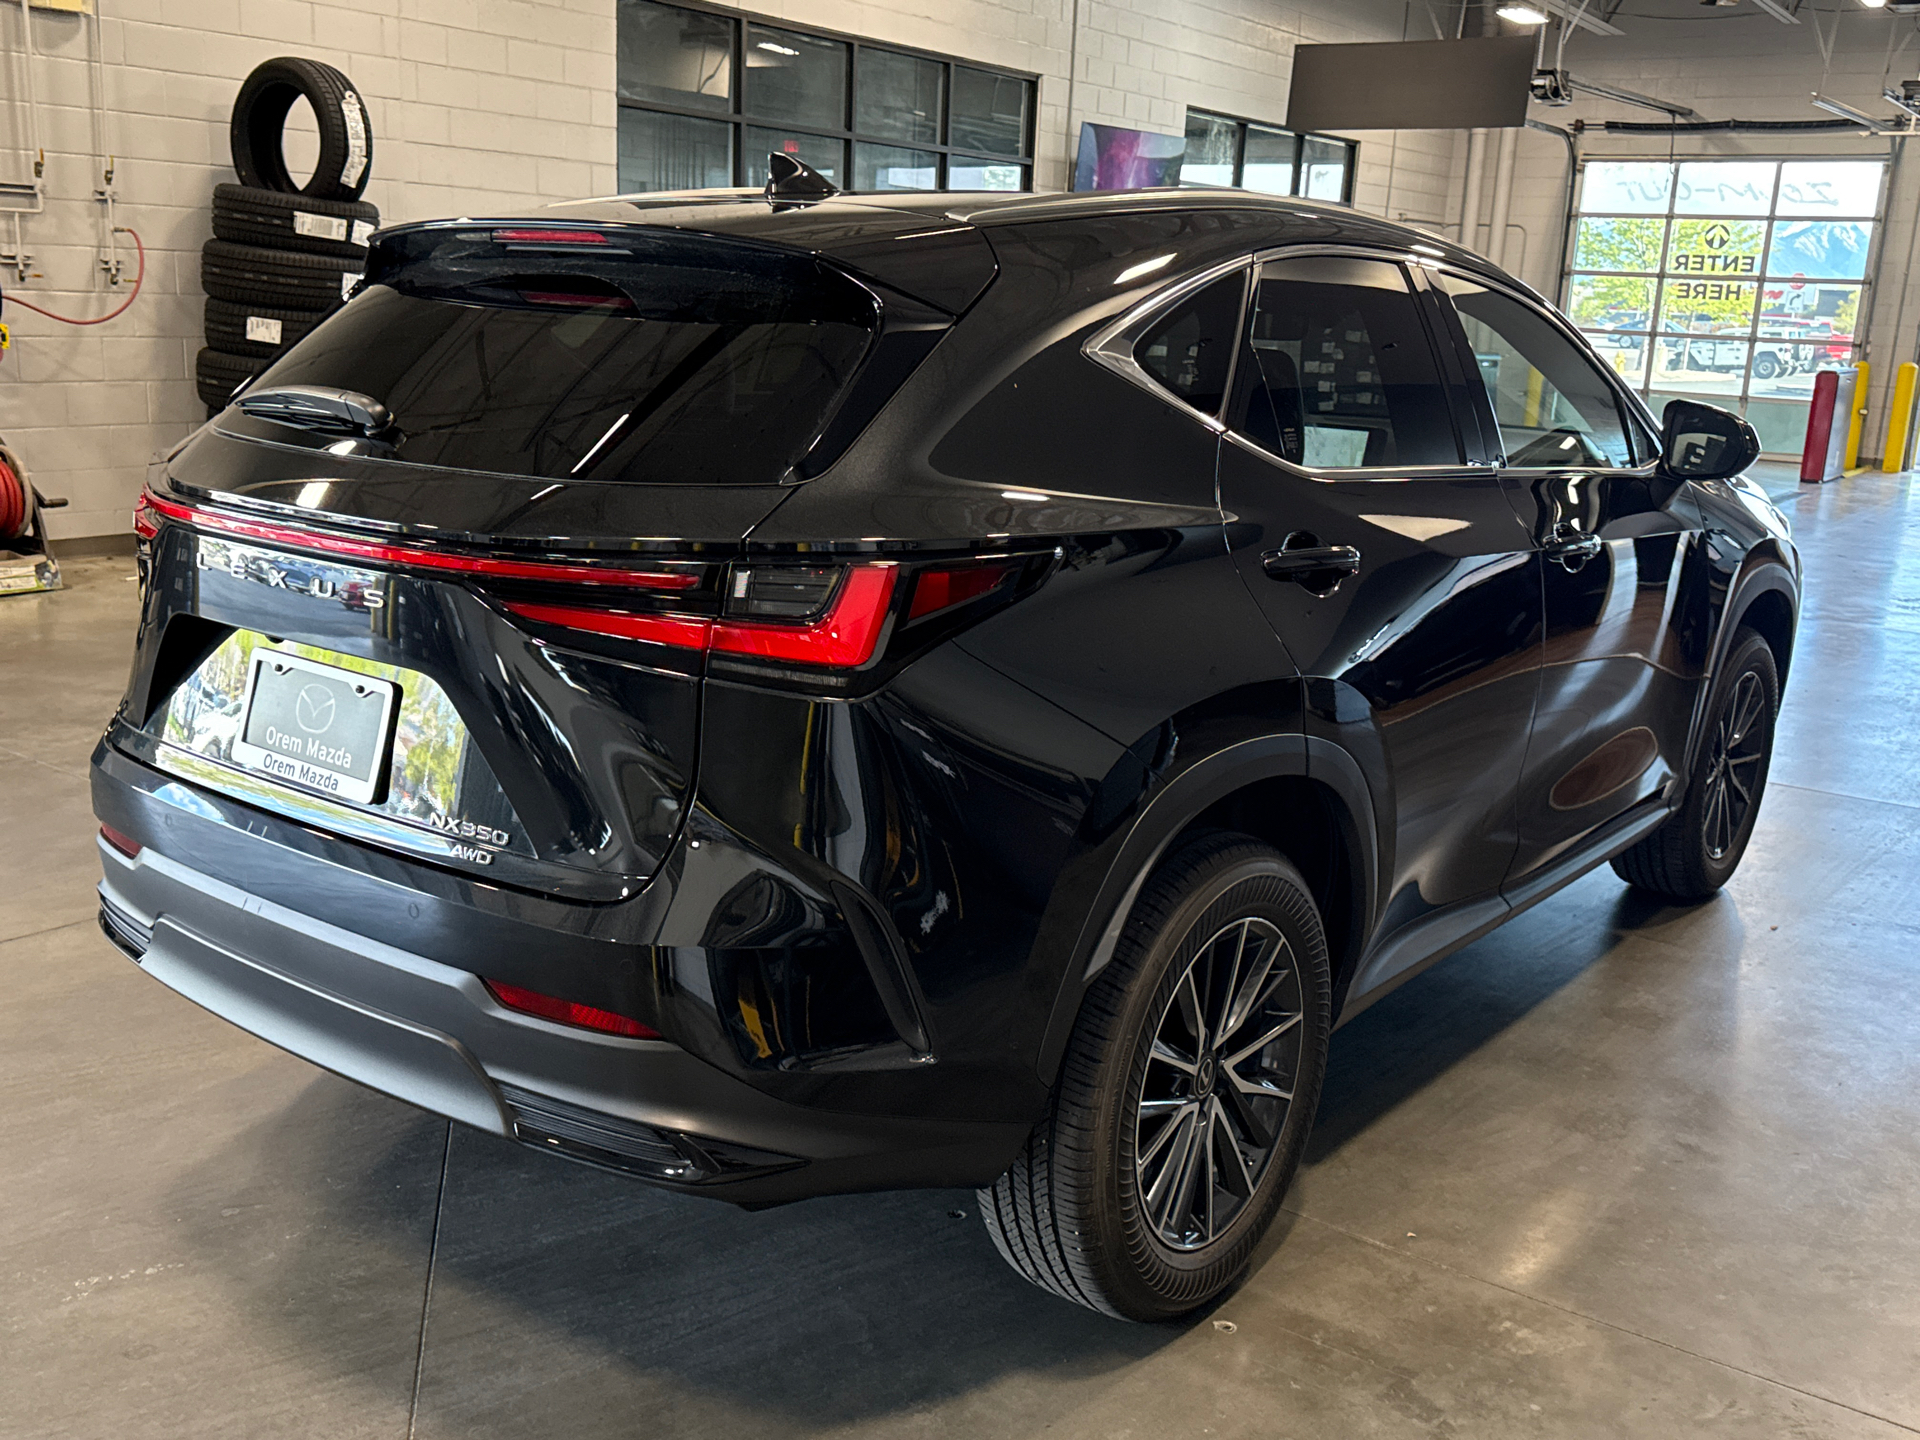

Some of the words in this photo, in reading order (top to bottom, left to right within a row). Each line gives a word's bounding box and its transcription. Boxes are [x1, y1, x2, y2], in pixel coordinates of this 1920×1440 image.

[196, 552, 386, 608] LEXUS
[266, 725, 302, 753] Orem
[306, 738, 352, 768] Mazda
[263, 753, 296, 777] Orem
[298, 764, 339, 791] Mazda
[429, 811, 510, 846] NX350
[450, 844, 493, 865] AWD
